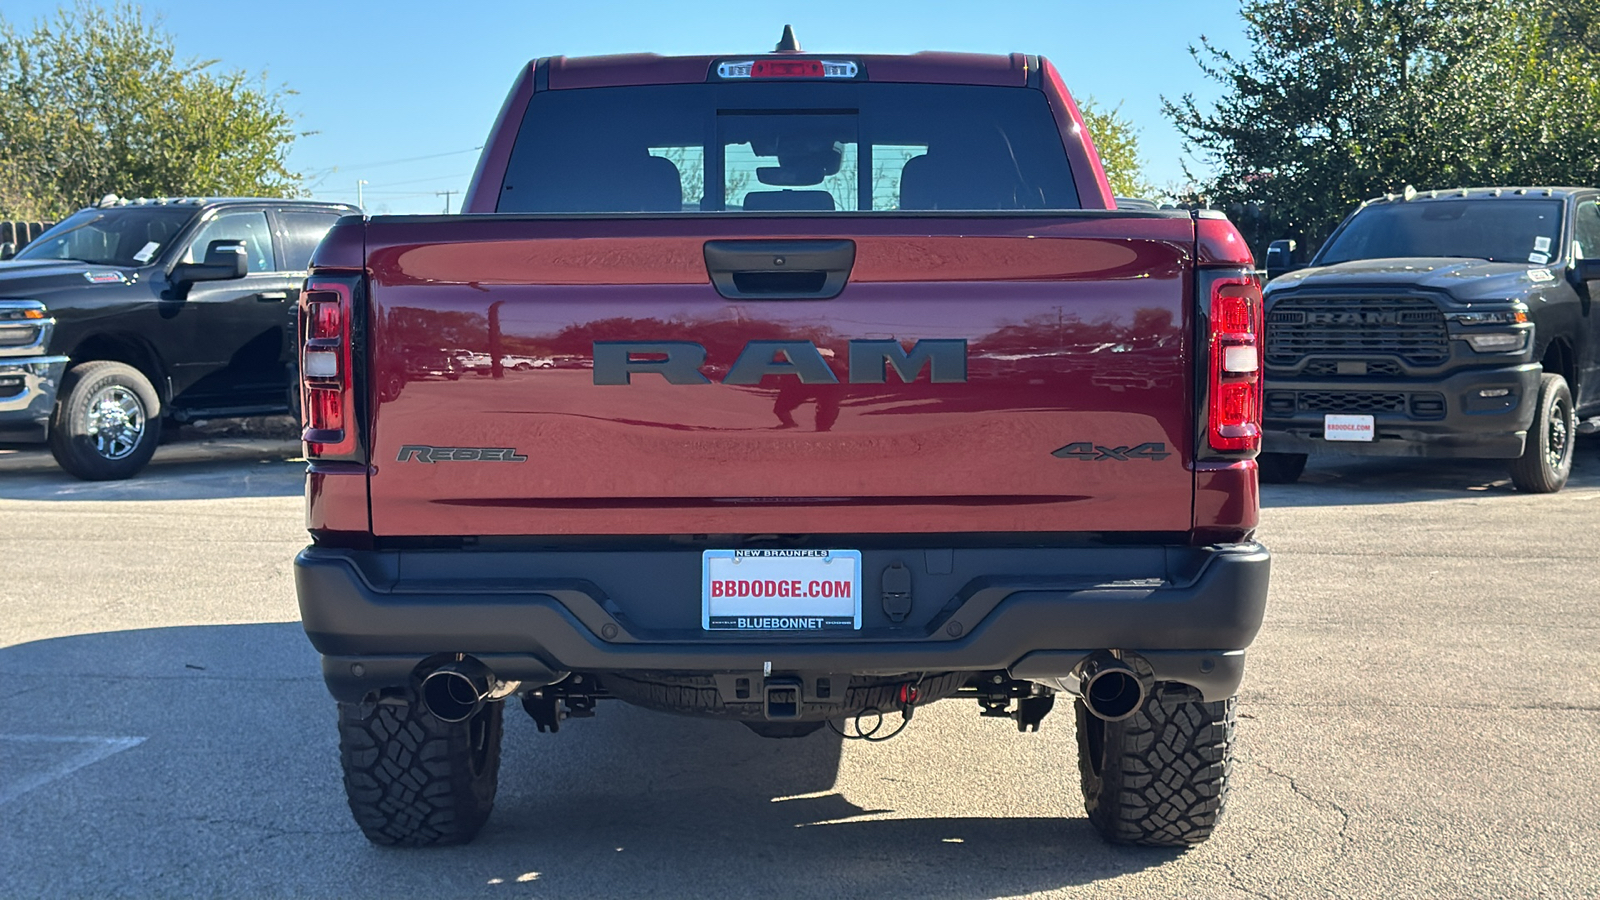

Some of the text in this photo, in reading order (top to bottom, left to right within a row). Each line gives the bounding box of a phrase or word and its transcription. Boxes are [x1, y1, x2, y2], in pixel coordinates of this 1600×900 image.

[1307, 312, 1397, 325] RAM
[593, 339, 968, 385] RAM
[396, 445, 528, 464] REBEL
[711, 580, 851, 598] BBDODGE.COM
[737, 618, 824, 629] BLUEBONNET
